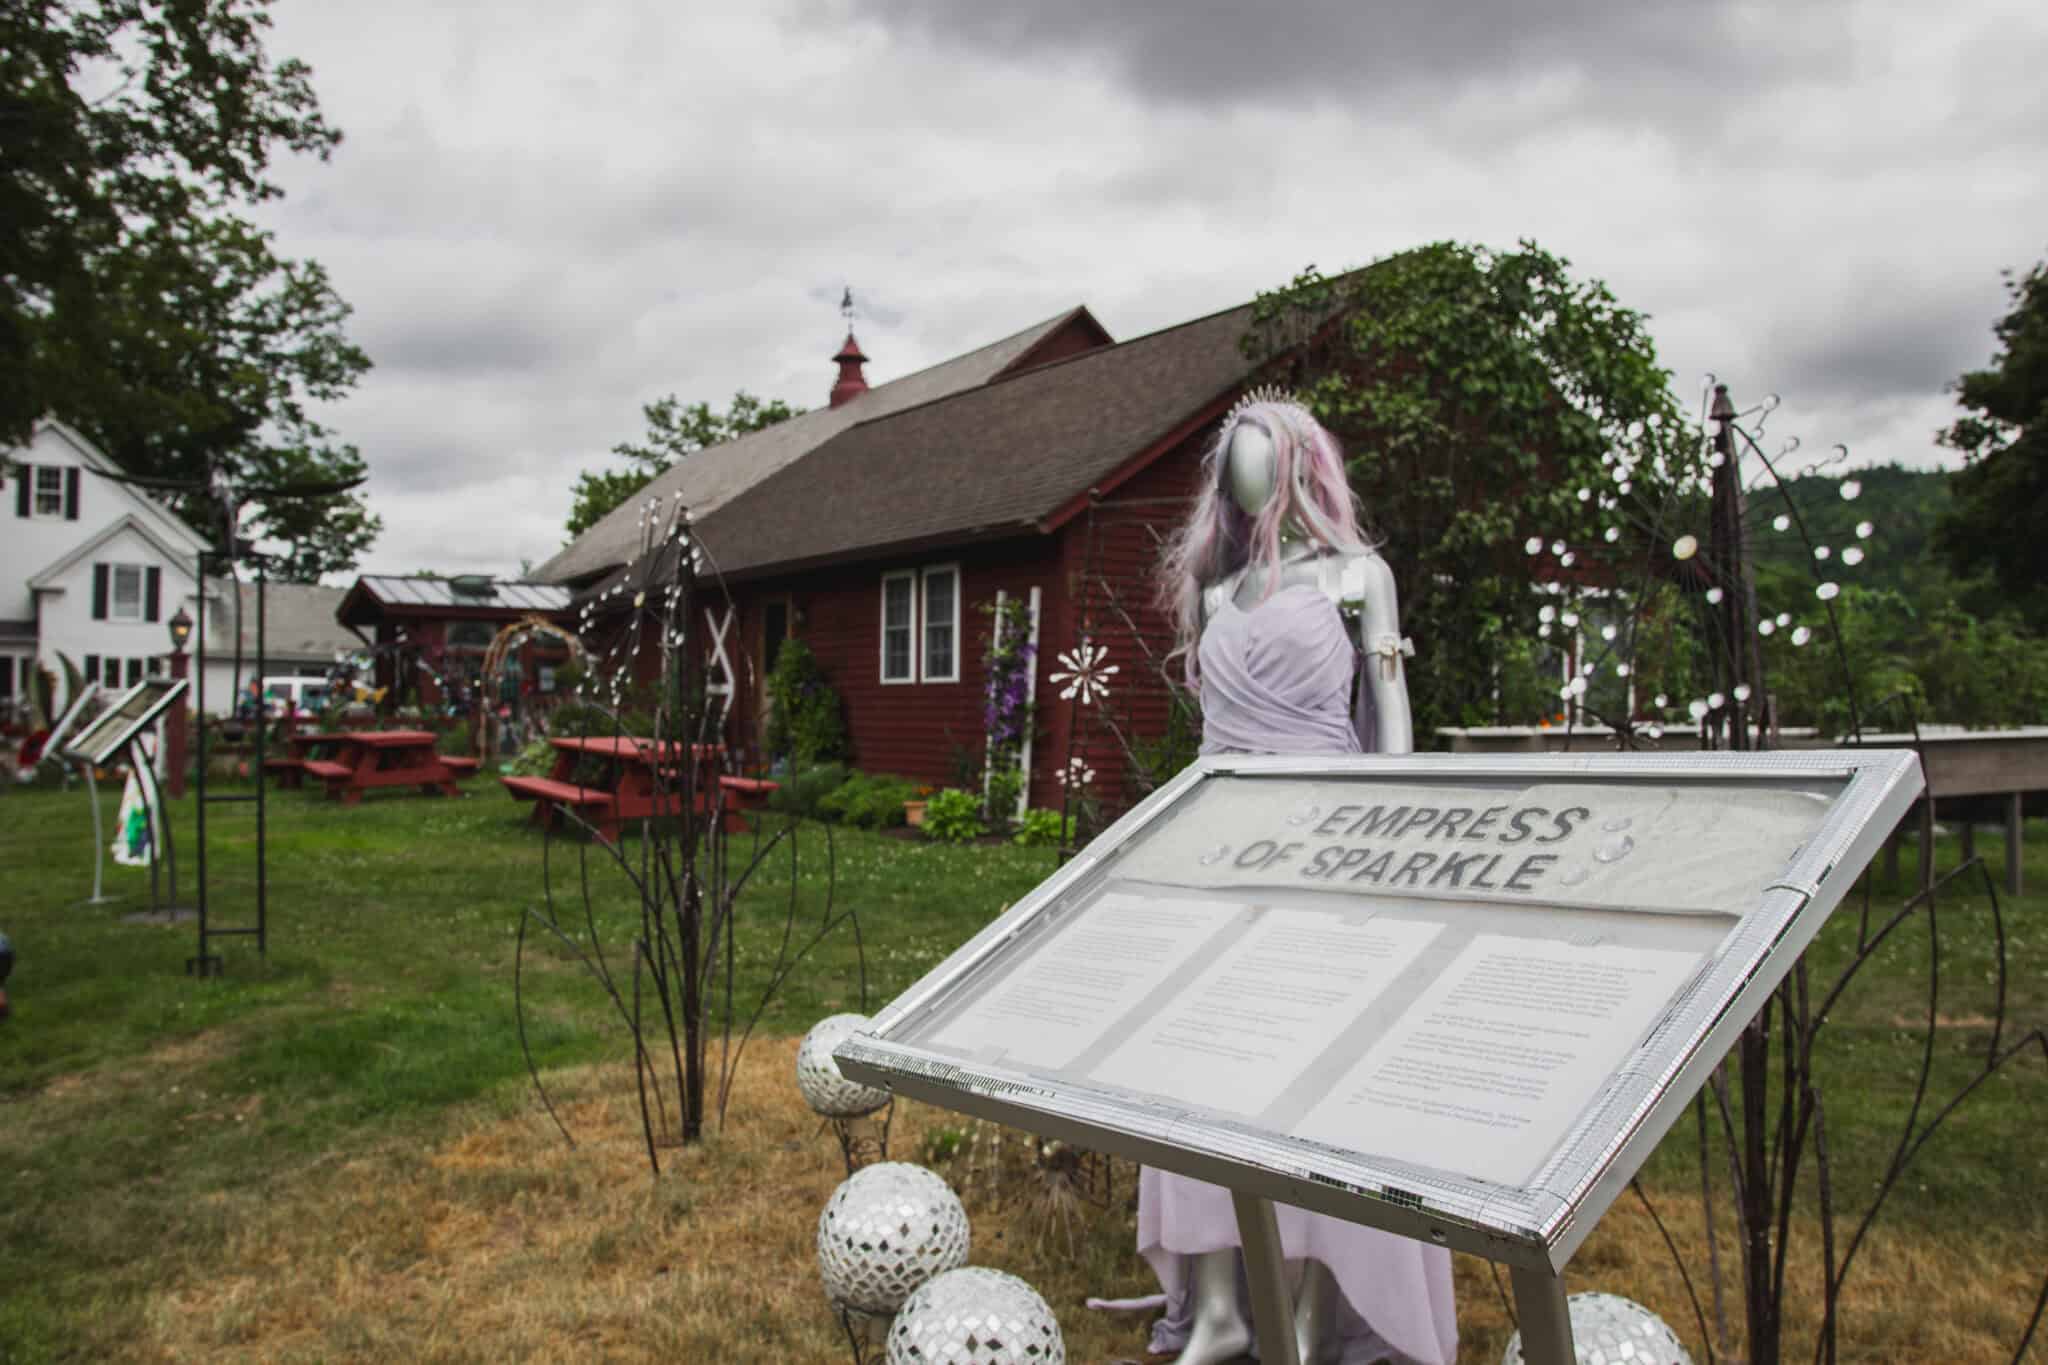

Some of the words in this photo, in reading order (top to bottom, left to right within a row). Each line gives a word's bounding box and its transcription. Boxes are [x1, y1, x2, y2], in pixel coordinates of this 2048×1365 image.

[1313, 805, 1590, 843] EMPRESS
[1233, 839, 1304, 869] OF
[1300, 846, 1559, 890] SPARKLE
